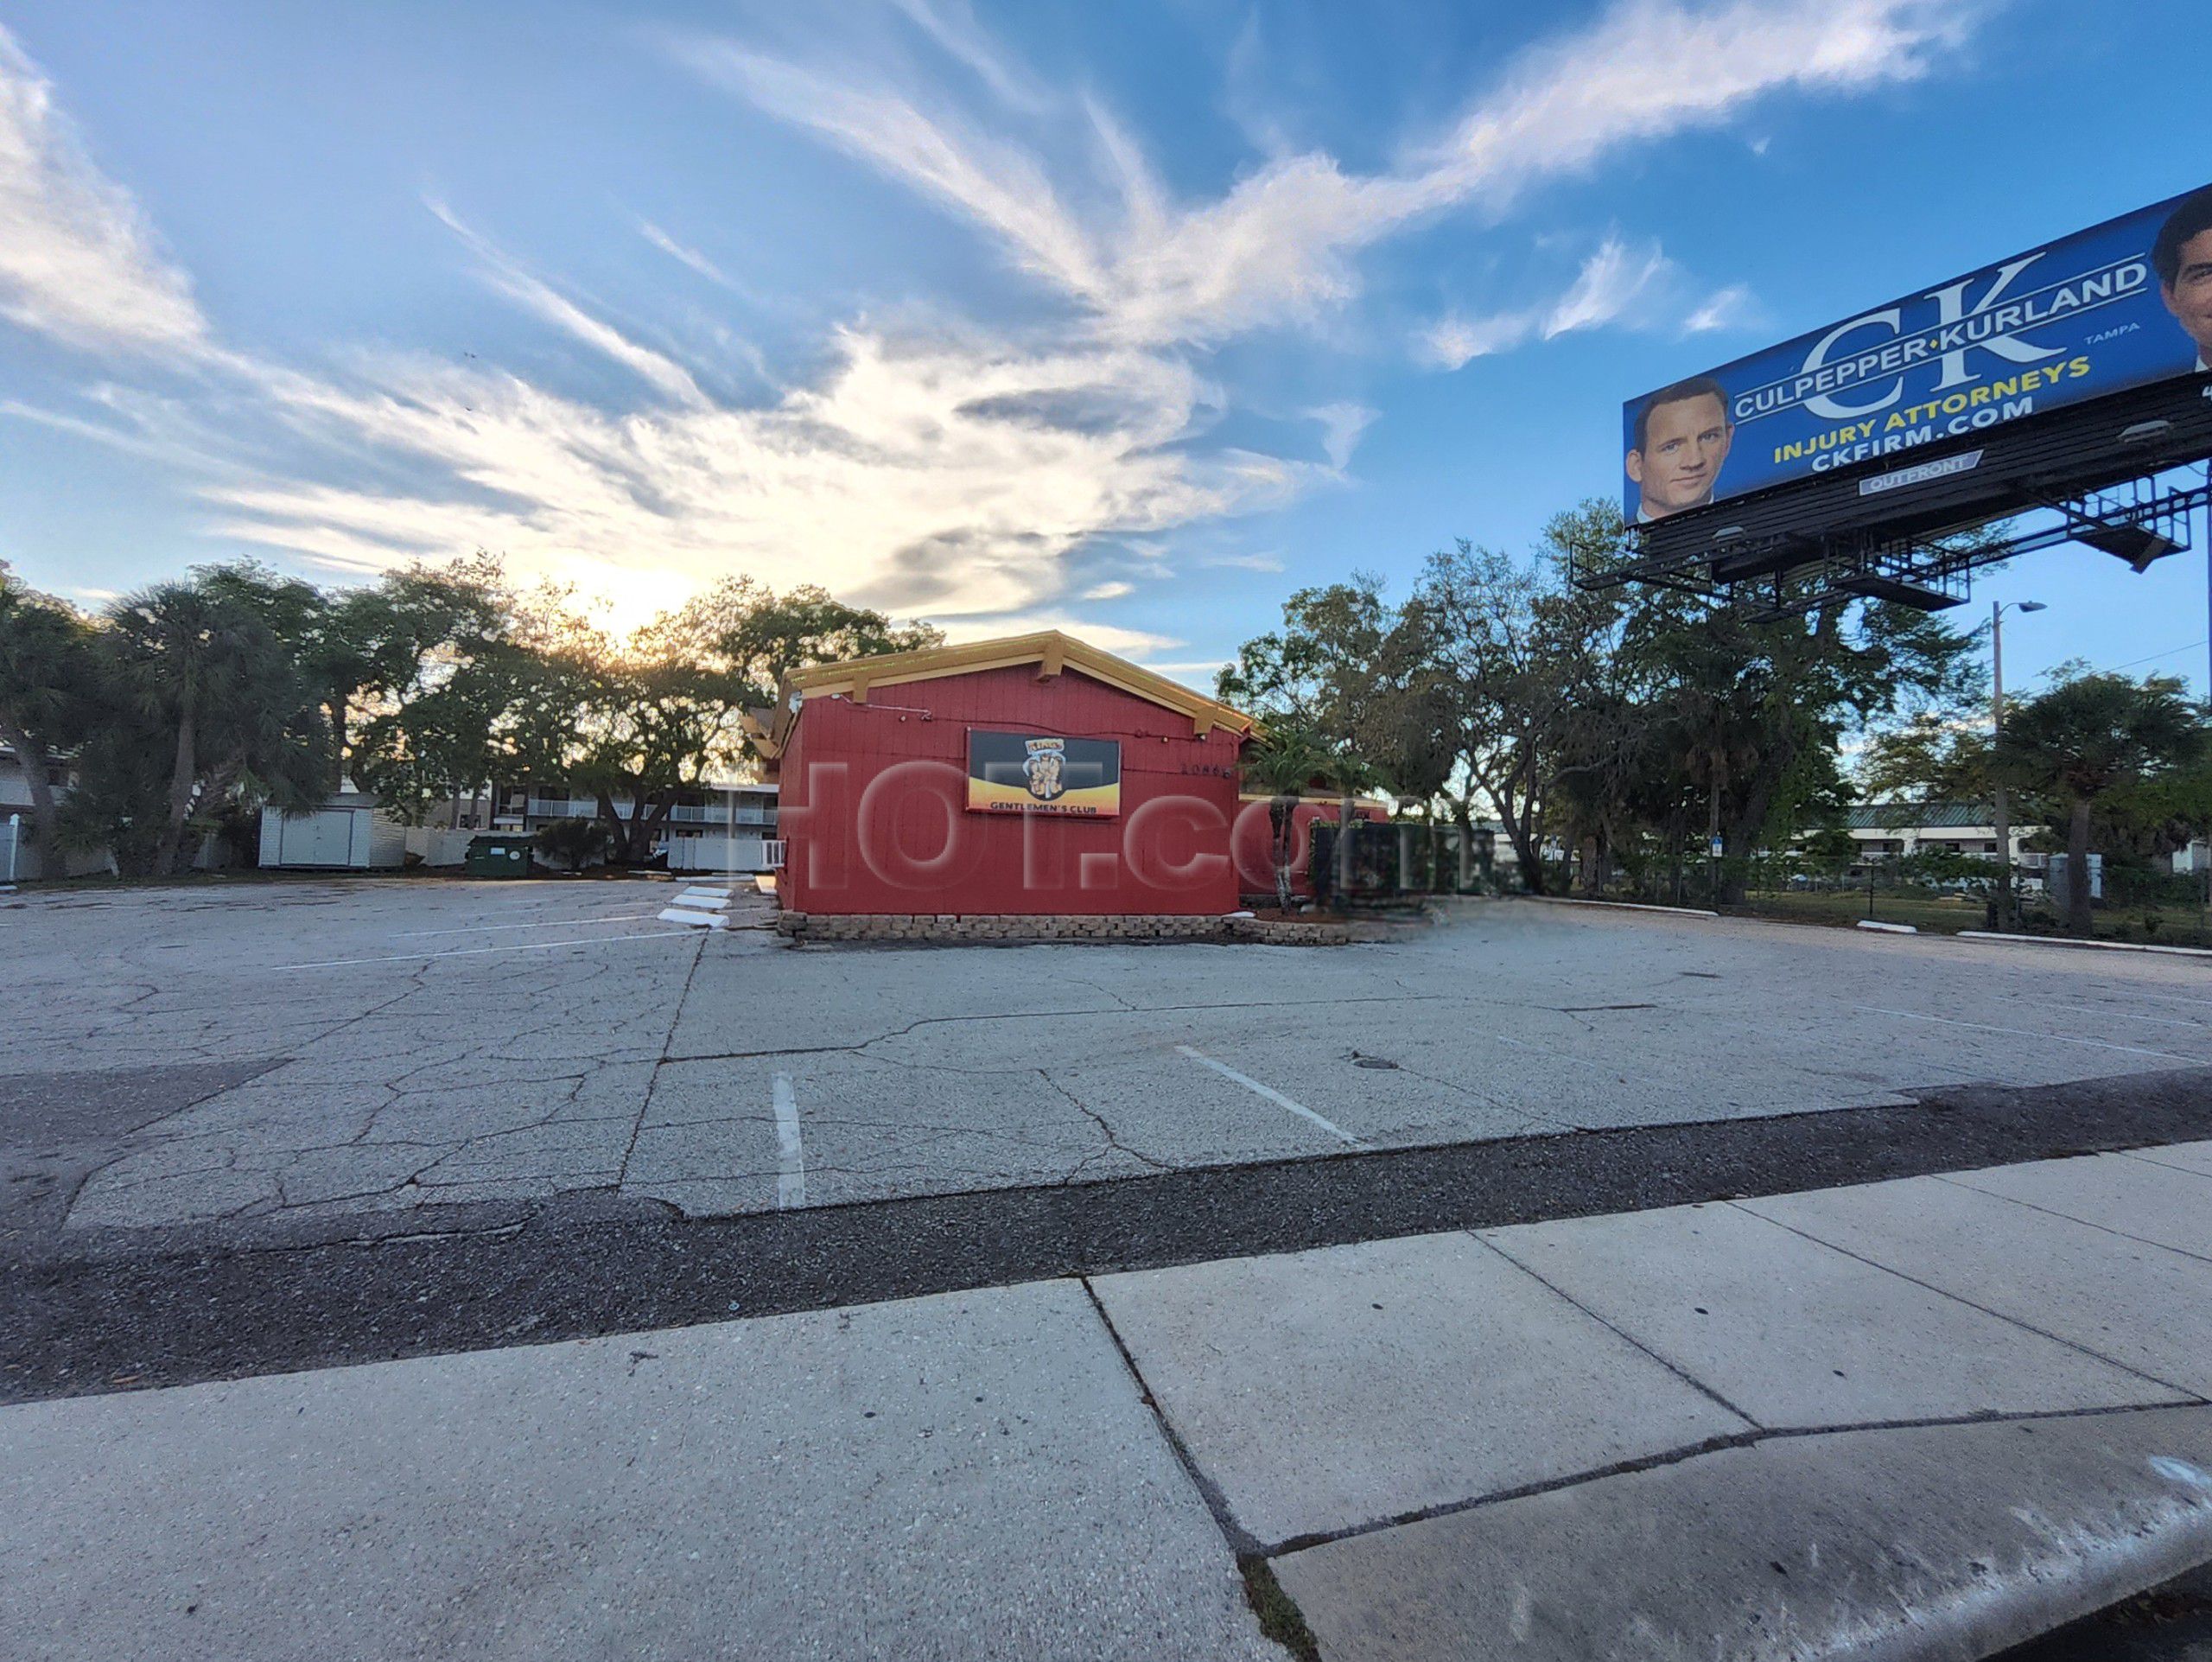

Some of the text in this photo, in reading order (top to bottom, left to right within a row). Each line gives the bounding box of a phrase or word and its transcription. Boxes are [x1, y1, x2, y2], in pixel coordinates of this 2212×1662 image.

[2083, 322, 2140, 345] TAMPA
[1774, 355, 2091, 464] INJURY ATTORNEYS
[1811, 396, 2034, 472] CKFIRM.COM
[1869, 455, 1968, 490] OUTFRONT
[990, 801, 1097, 814] GENTLEMEN'S CLUB
